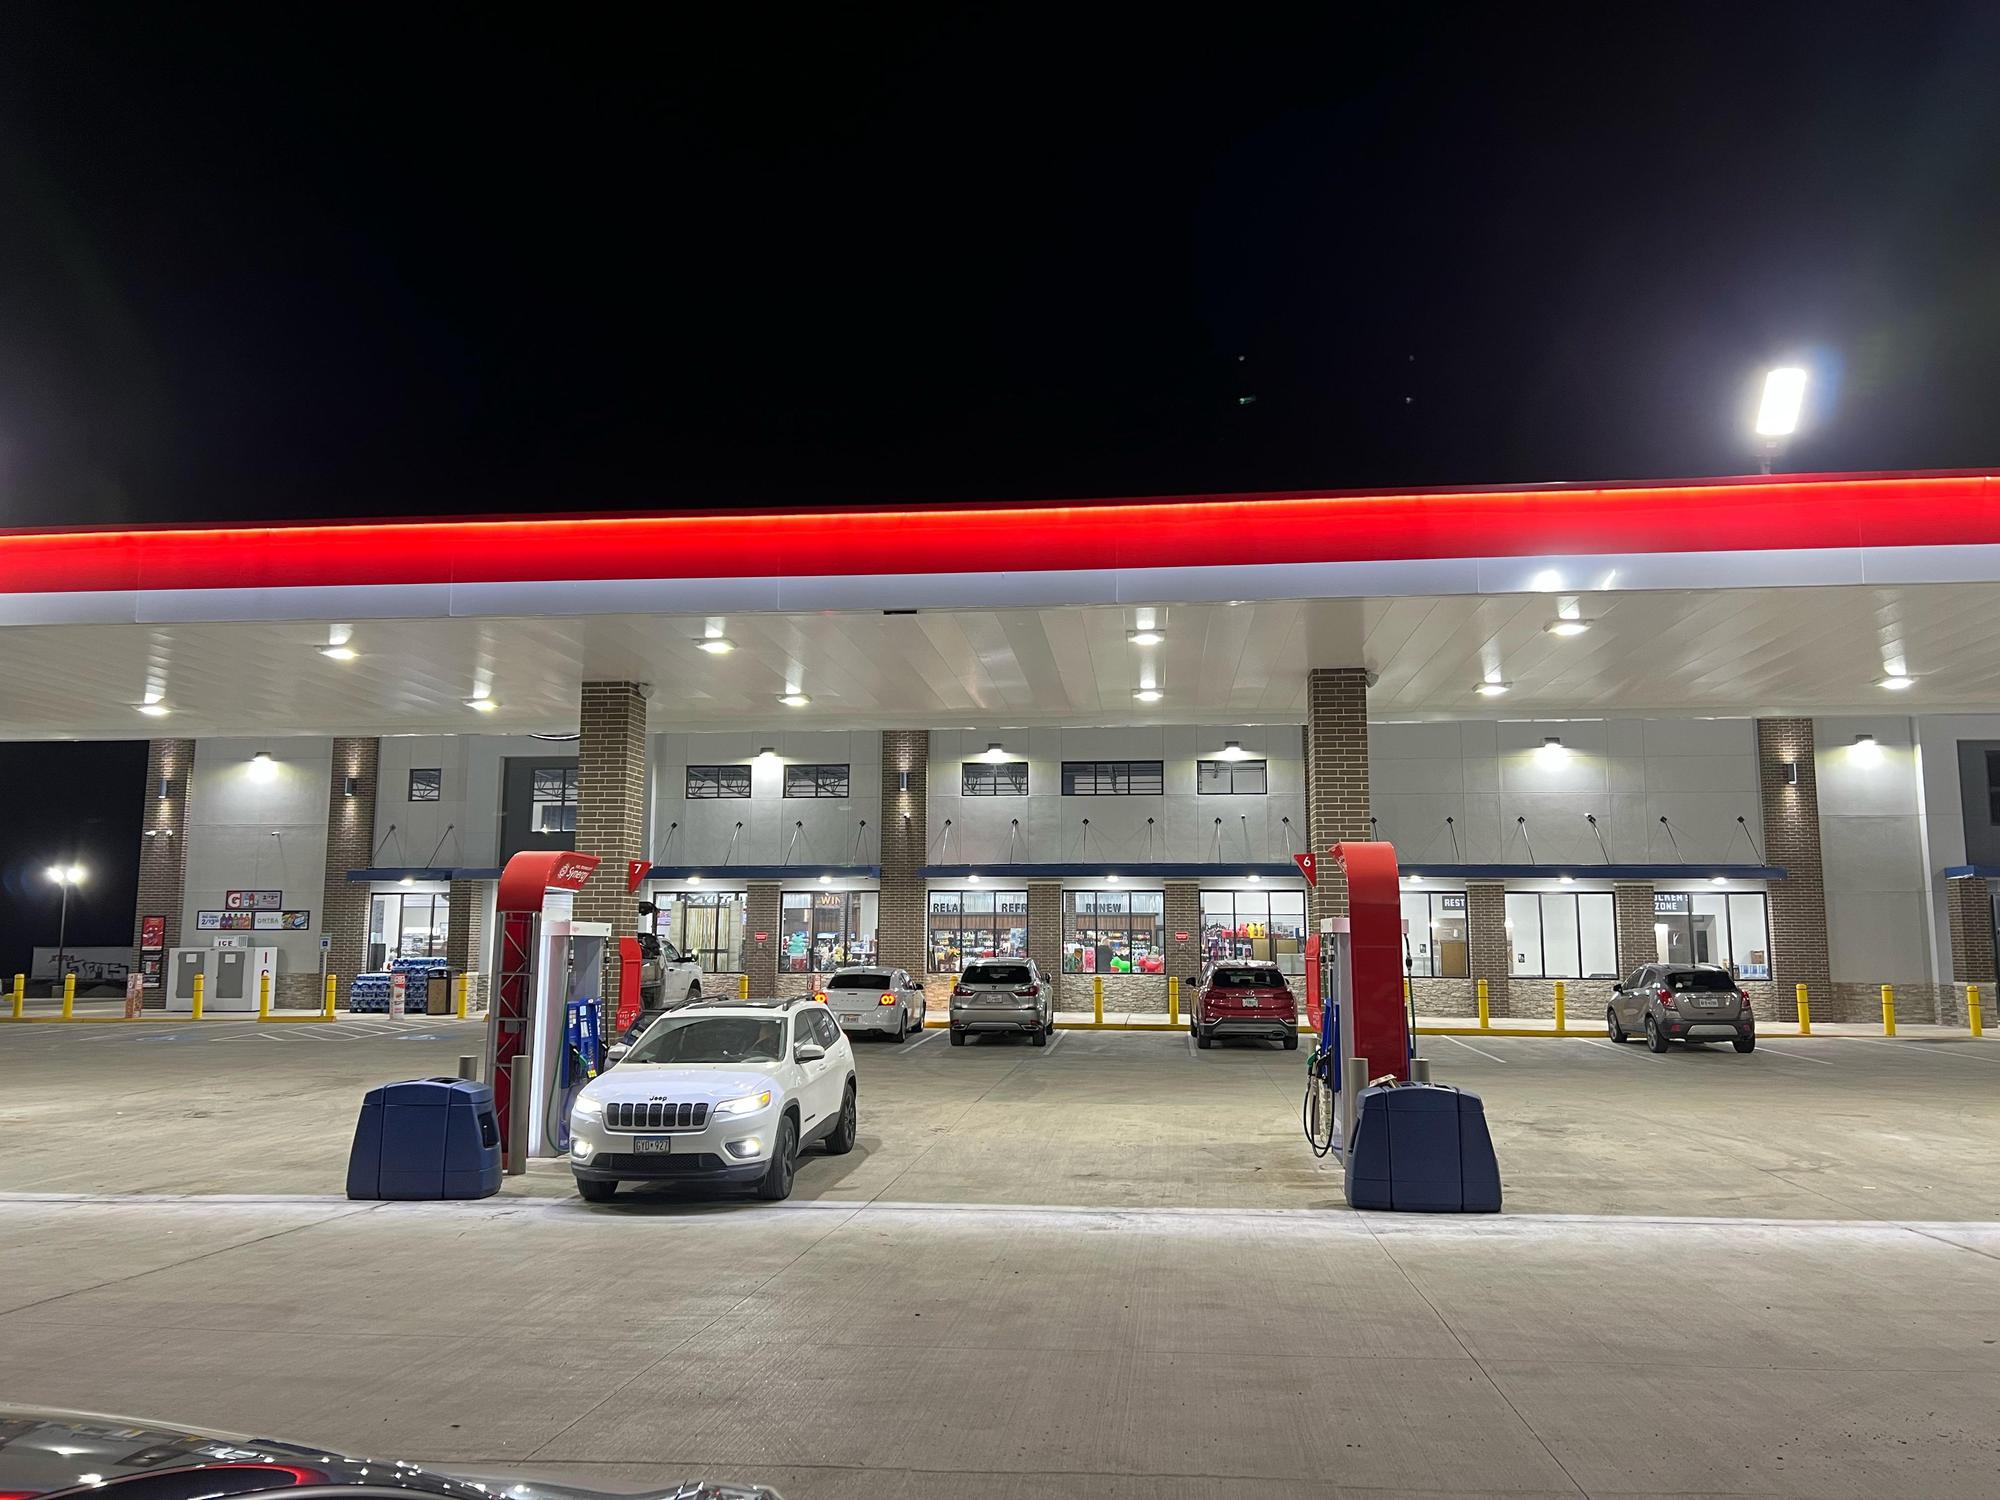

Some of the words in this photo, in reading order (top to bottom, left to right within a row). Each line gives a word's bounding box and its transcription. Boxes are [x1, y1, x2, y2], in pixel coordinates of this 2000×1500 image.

[1303, 856, 1311, 867] 6
[634, 863, 642, 874] 7
[566, 866, 590, 883] Synergy
[1444, 898, 1465, 907] REST
[1654, 902, 1677, 911] ZONE
[933, 903, 965, 913] RELAX
